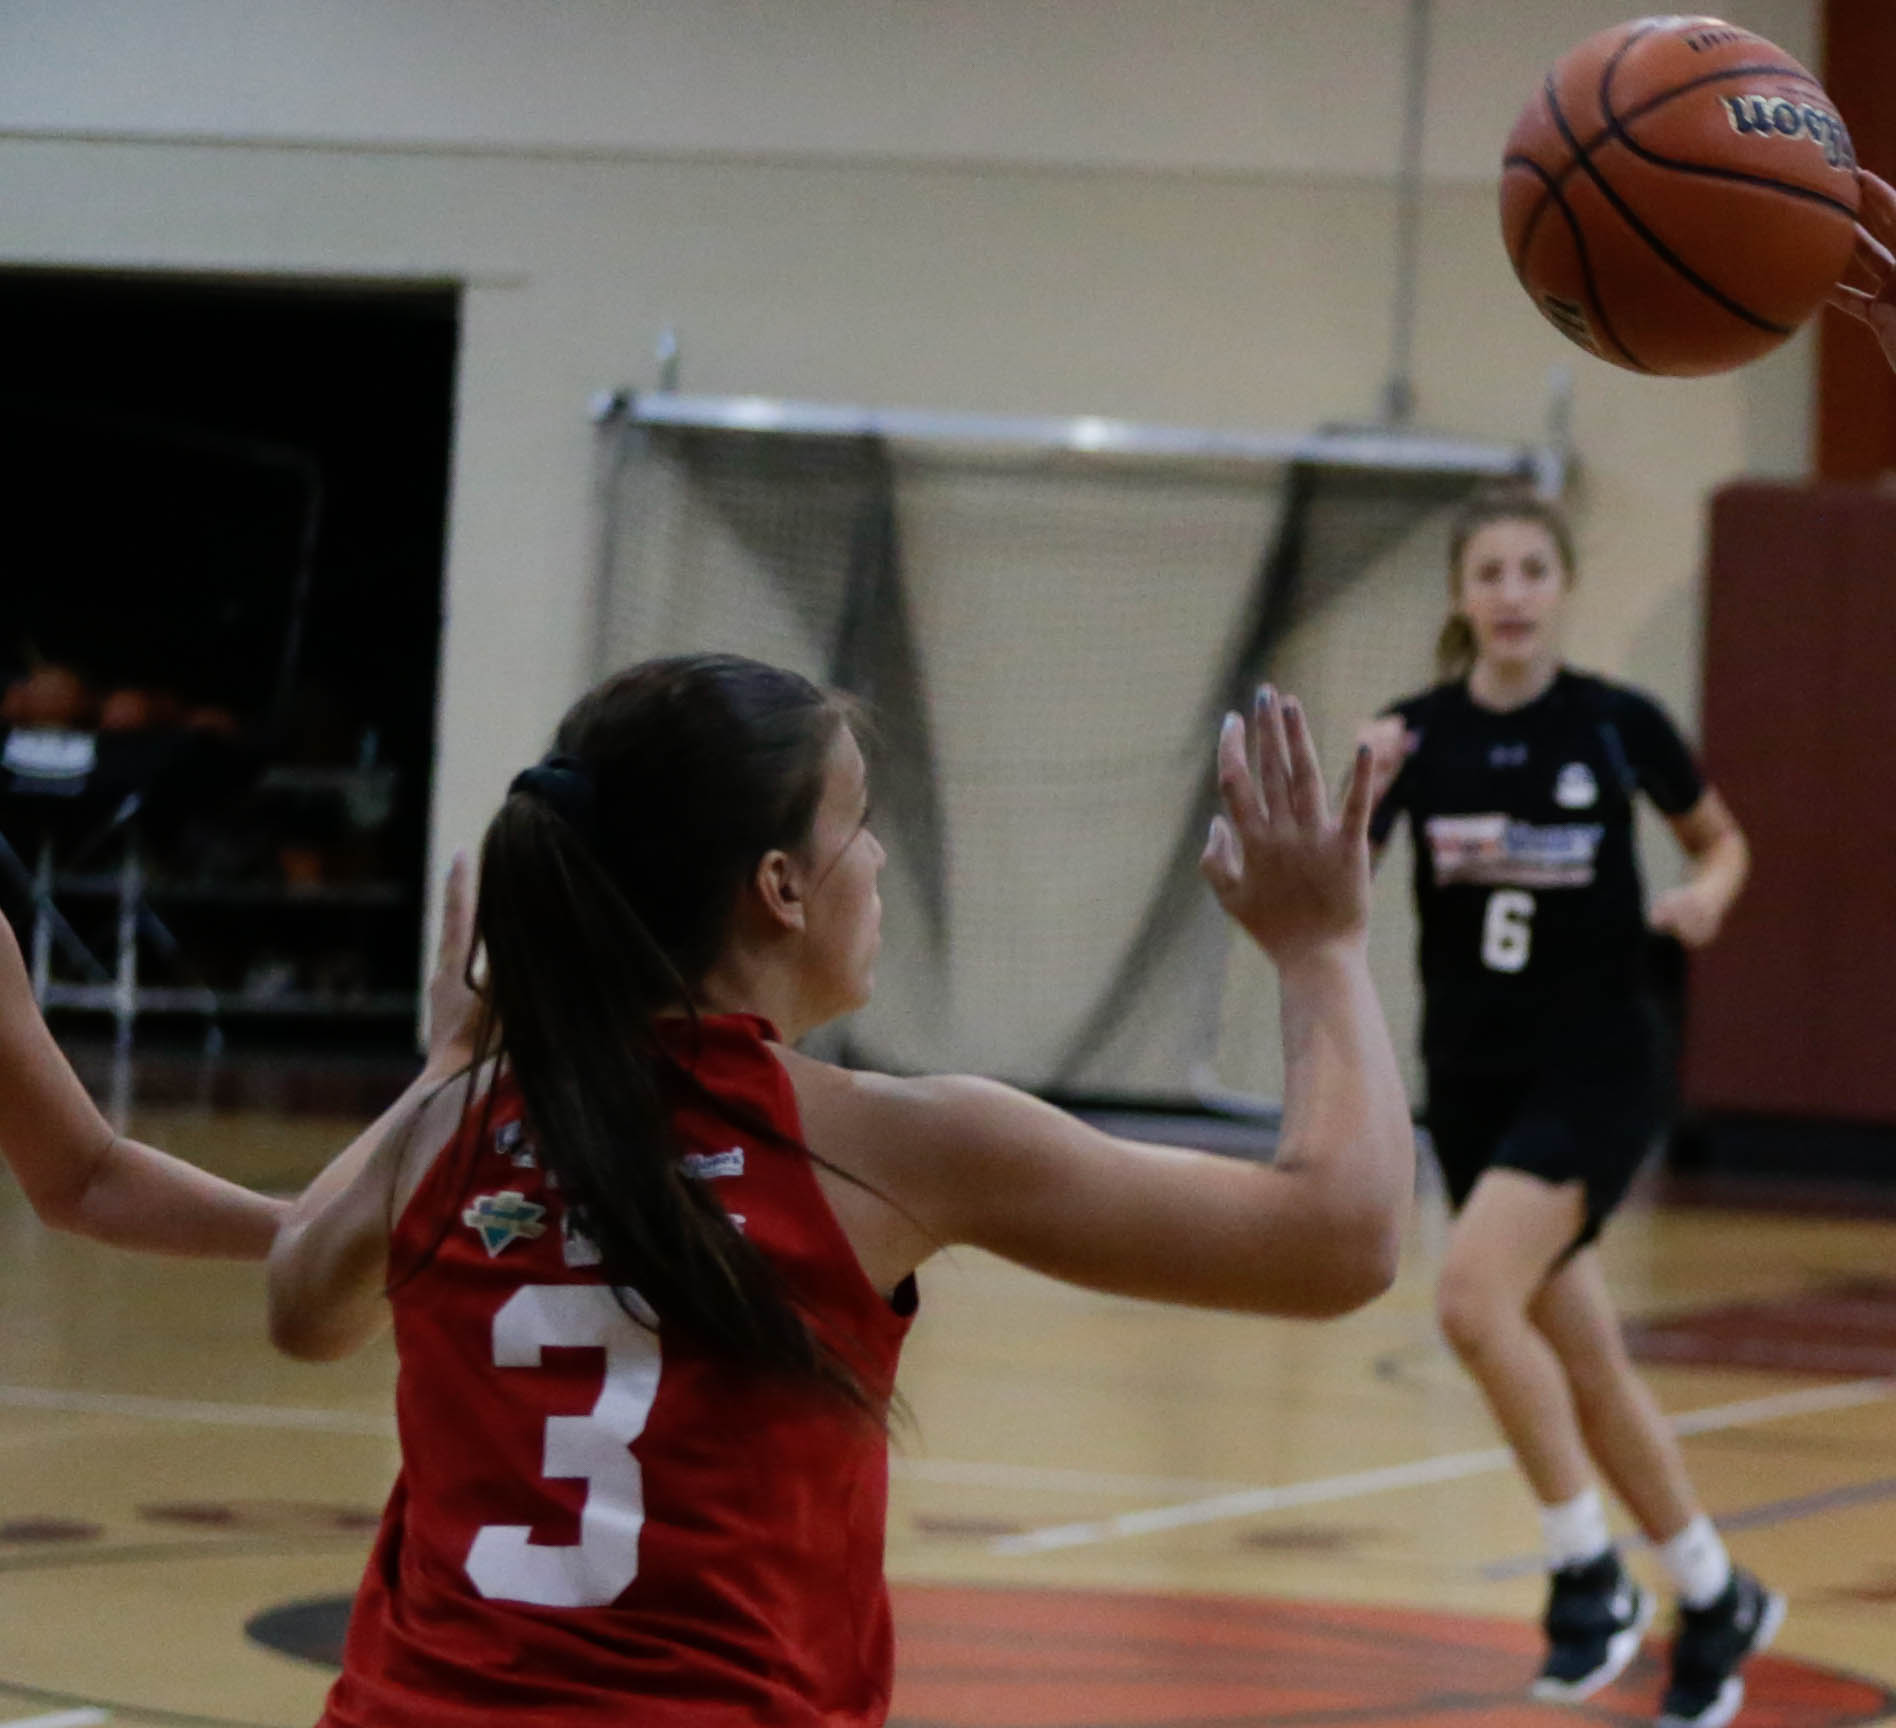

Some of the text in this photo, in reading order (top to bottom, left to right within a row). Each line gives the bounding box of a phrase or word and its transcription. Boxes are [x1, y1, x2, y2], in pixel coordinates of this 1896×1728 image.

[1721, 96, 1855, 171] lson
[1482, 890, 1536, 973] 6
[463, 1284, 663, 1608] 3
